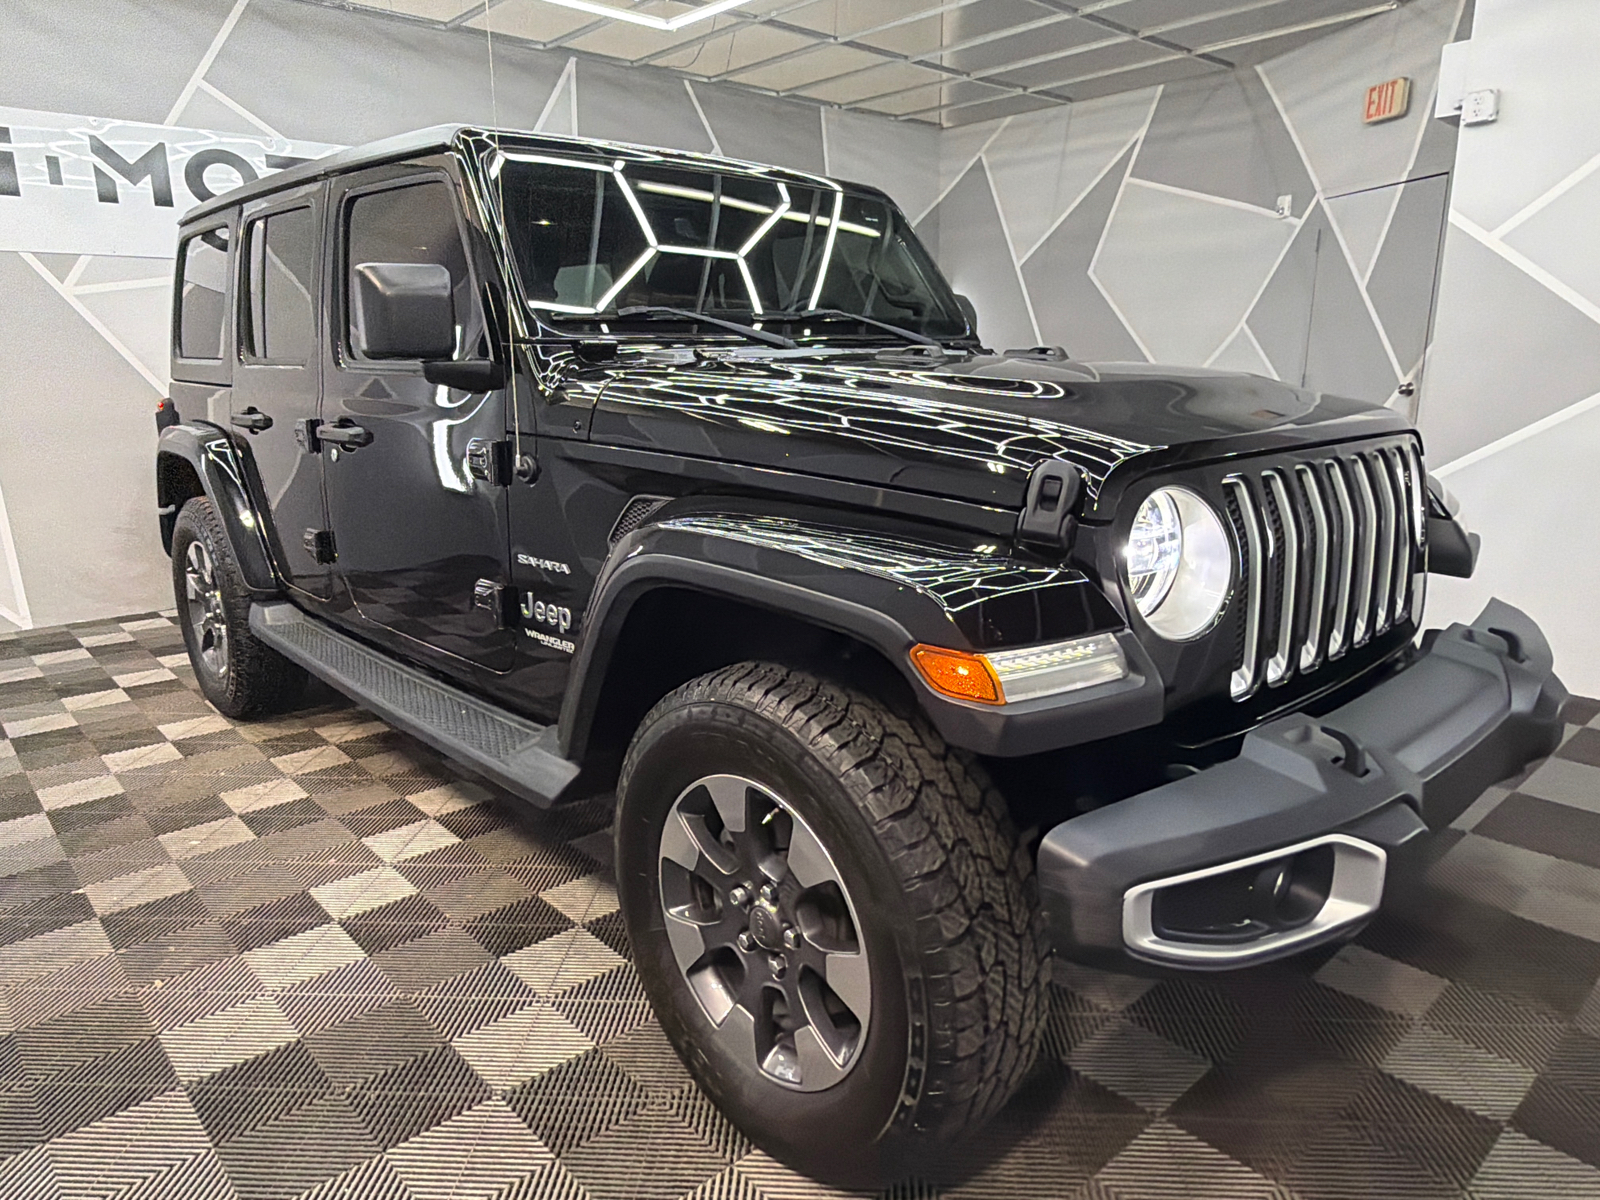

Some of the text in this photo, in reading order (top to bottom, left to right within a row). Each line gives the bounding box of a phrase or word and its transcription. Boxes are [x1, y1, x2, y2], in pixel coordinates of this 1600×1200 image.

[1366, 80, 1398, 120] EXIT
[517, 553, 571, 575] SAHARA
[520, 591, 571, 634] Jeep
[524, 627, 575, 651] WRANGLER
